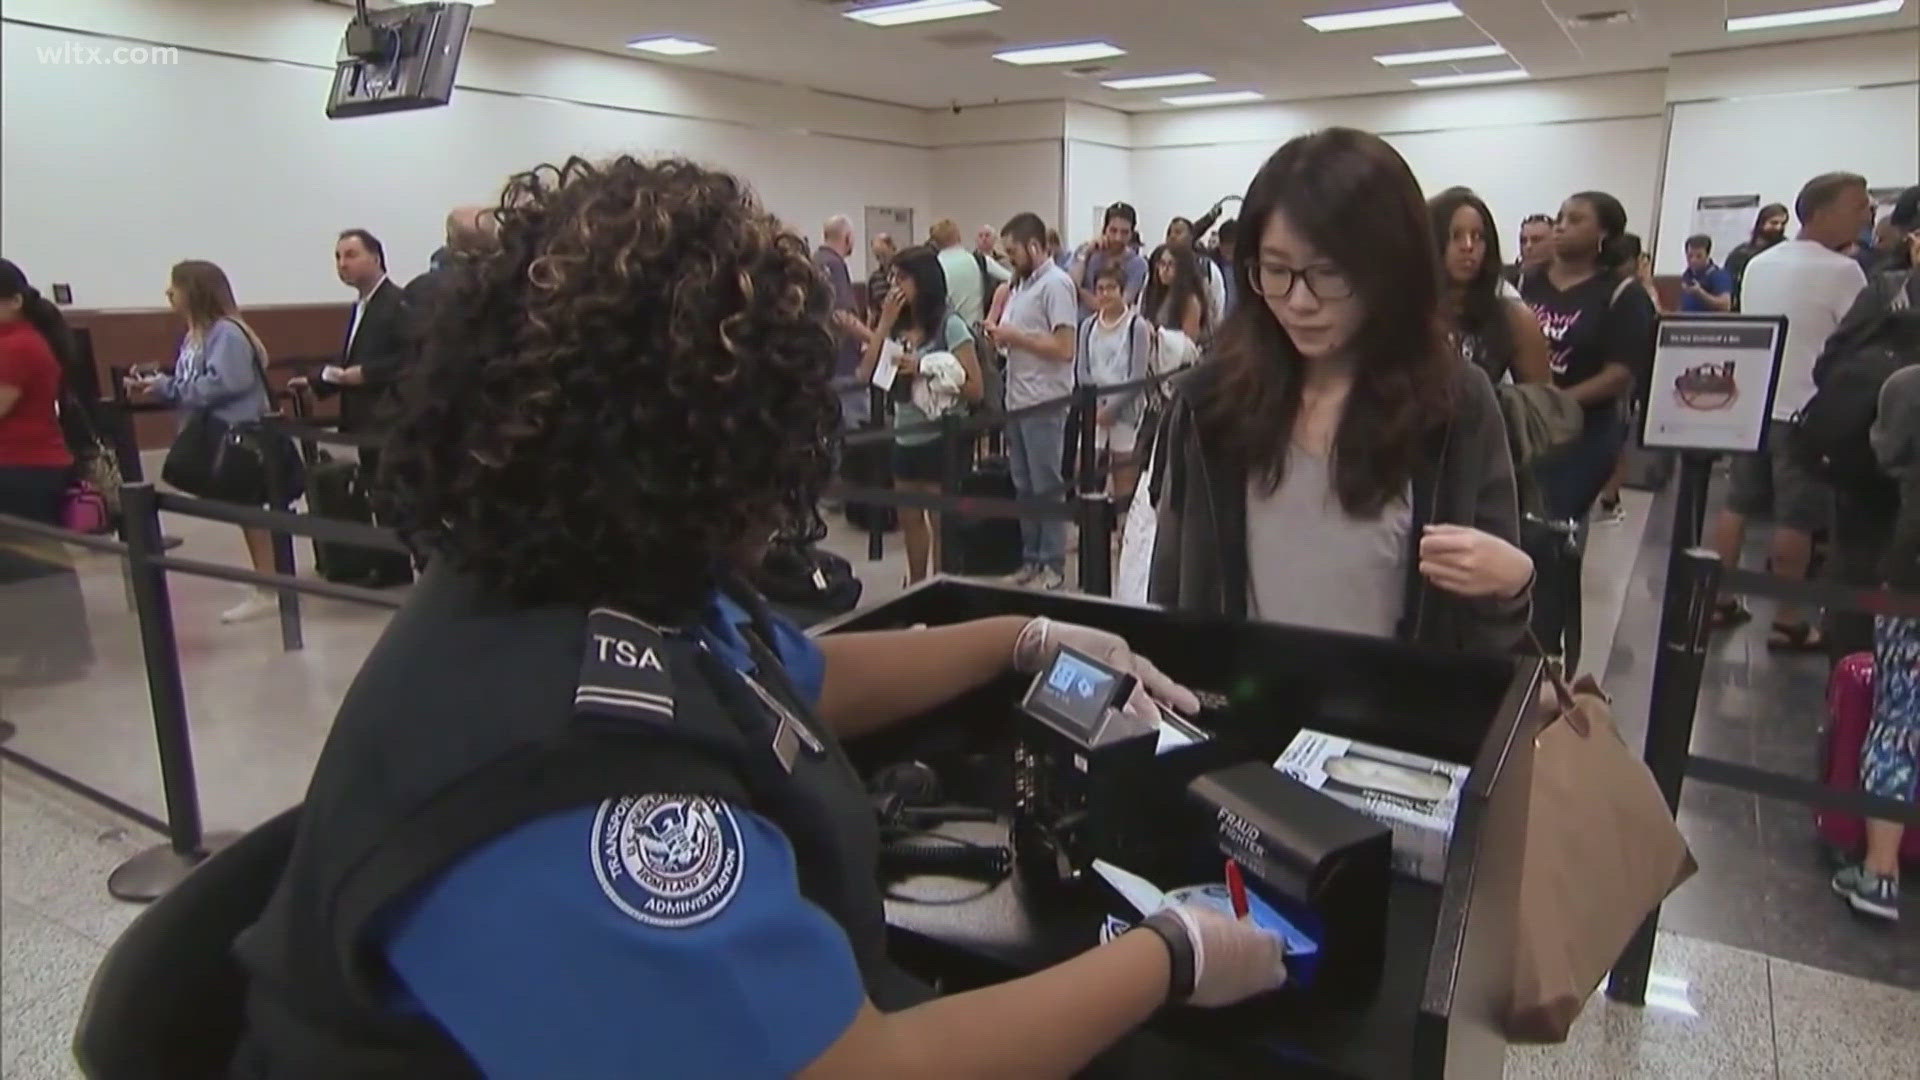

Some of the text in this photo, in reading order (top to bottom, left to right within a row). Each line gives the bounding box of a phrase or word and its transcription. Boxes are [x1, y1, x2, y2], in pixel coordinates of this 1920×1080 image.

[595, 635, 663, 671] TSA
[606, 794, 637, 881] TRANSPOR
[1217, 806, 1260, 840] FRAUD
[636, 867, 700, 893] HOMELAND
[644, 848, 736, 914] ADMINISTRATION
